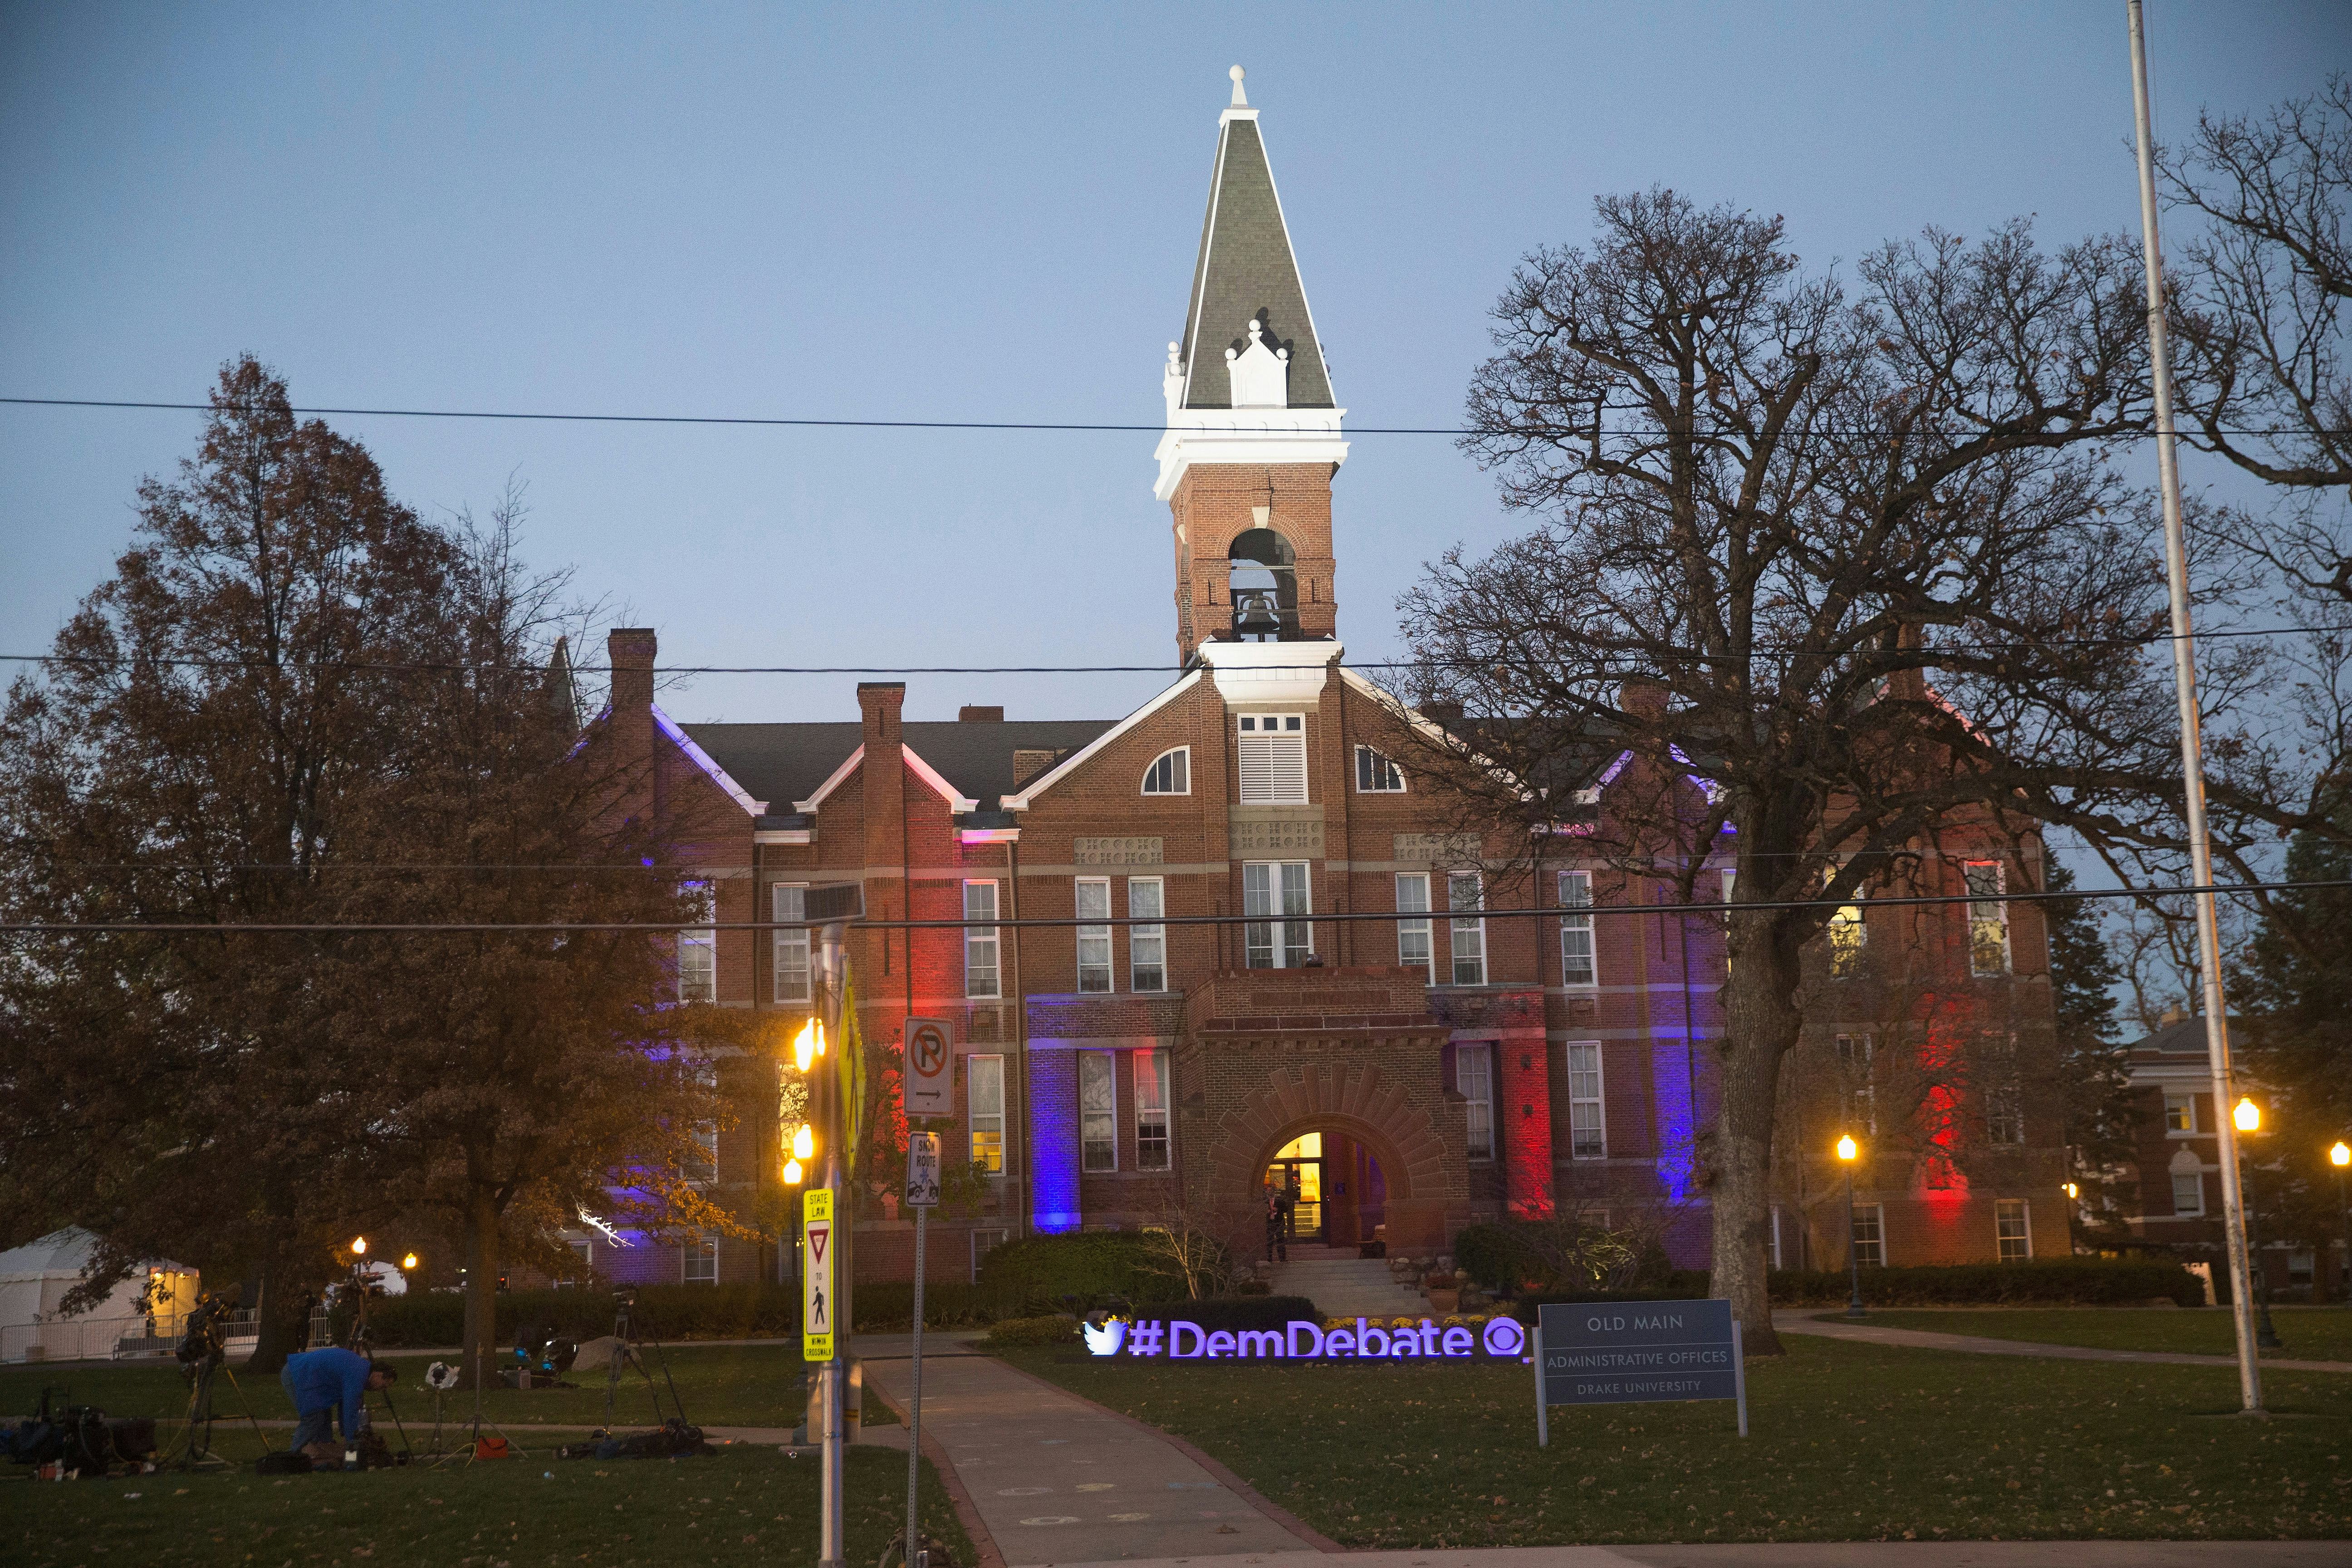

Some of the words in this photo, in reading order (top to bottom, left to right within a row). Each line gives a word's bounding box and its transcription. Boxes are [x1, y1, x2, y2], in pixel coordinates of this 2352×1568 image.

[919, 1139, 935, 1152] SNOW
[916, 1155, 936, 1167] ROUTE
[810, 1194, 828, 1204] STATE
[812, 1207, 825, 1217] LAW
[816, 1272, 822, 1280] TO
[1588, 1317, 1625, 1331] OLD
[1635, 1315, 1683, 1329] MAIN
[1128, 1317, 1474, 1359] #DemDebate
[1547, 1353, 1664, 1368] ADMINISTRATIVE
[1669, 1351, 1728, 1364] OFFICES
[1578, 1383, 1620, 1395] DRAKE
[1625, 1380, 1701, 1393] UNIVERSITY
